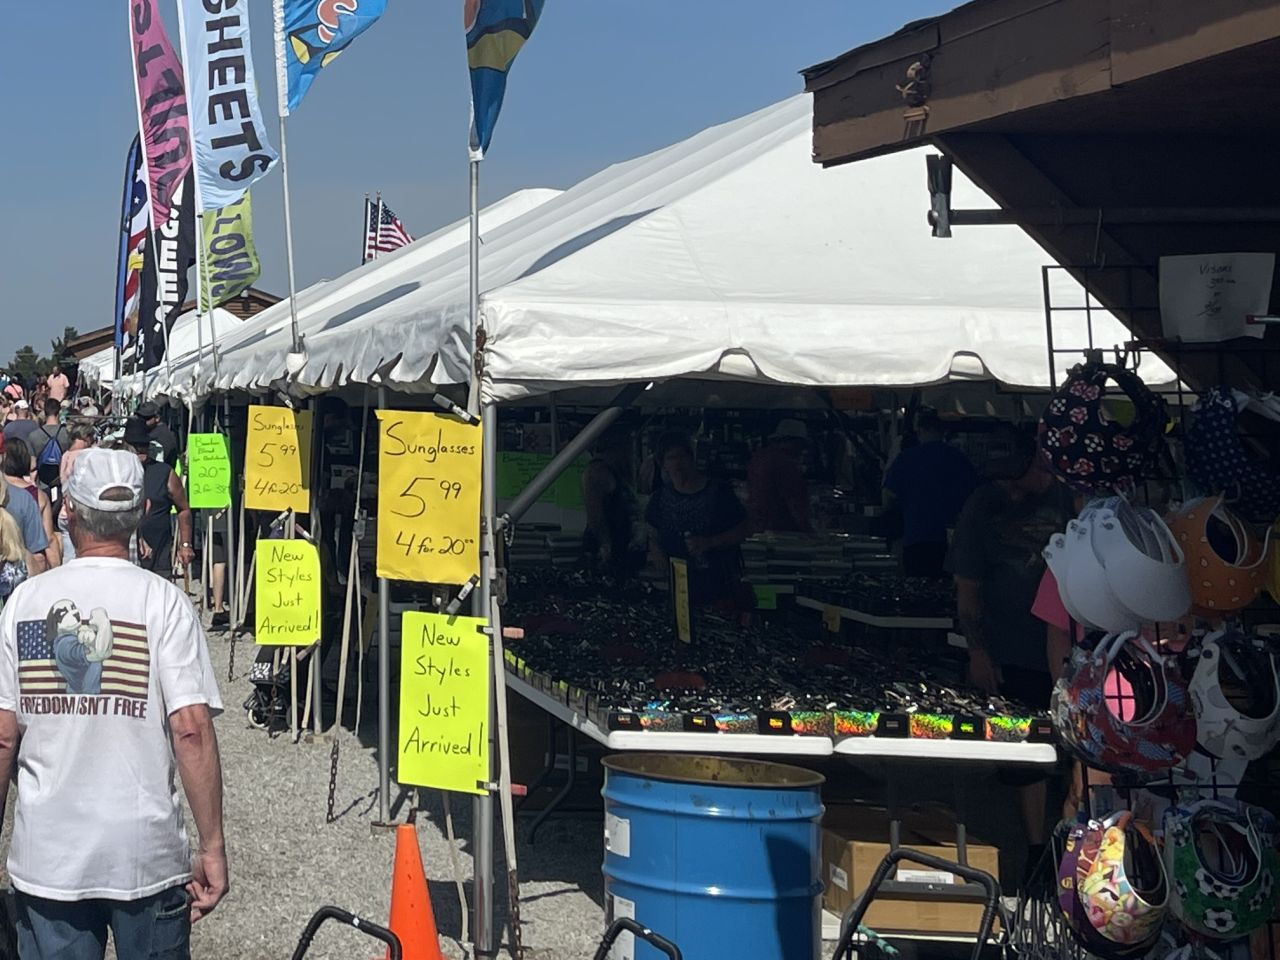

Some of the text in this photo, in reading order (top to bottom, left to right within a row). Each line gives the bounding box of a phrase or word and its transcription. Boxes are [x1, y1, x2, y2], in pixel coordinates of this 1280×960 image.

[384, 421, 475, 463] Sunglasses
[254, 478, 269, 496] 4
[272, 545, 304, 563] New
[395, 531, 416, 557] 4
[417, 536, 434, 554] for
[267, 567, 312, 588] Styles
[272, 591, 303, 608] Just
[258, 609, 319, 635] Arrived!
[422, 623, 461, 648] New
[414, 654, 471, 685] Styles
[113, 697, 148, 719] FREE
[418, 693, 461, 717] Just
[404, 721, 483, 768] Arrived!
